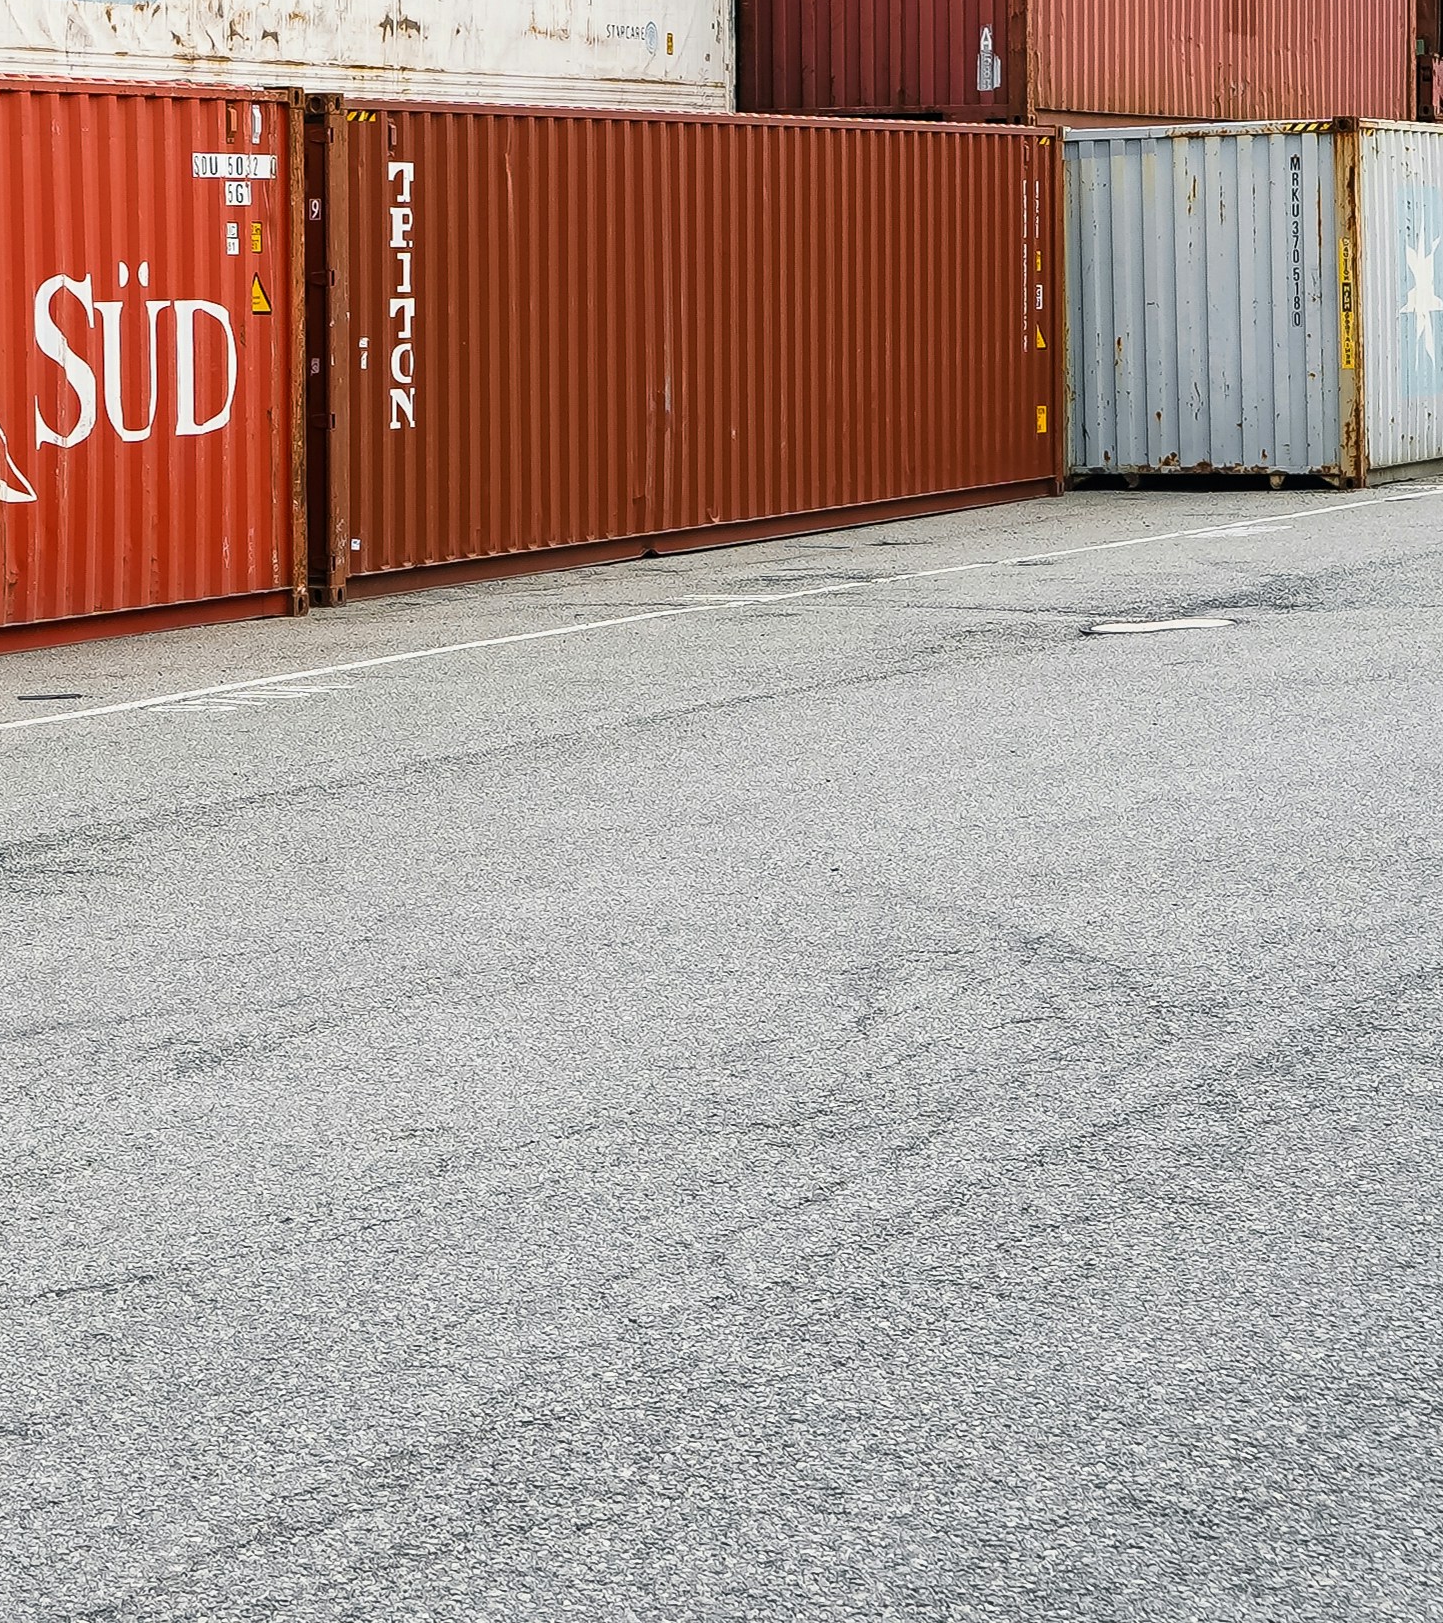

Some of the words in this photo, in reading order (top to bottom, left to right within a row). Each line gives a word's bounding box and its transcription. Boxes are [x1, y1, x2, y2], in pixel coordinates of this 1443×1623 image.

[310, 199, 320, 219] 9
[1290, 156, 1301, 218] MRKU
[34, 260, 238, 451] SÜD
